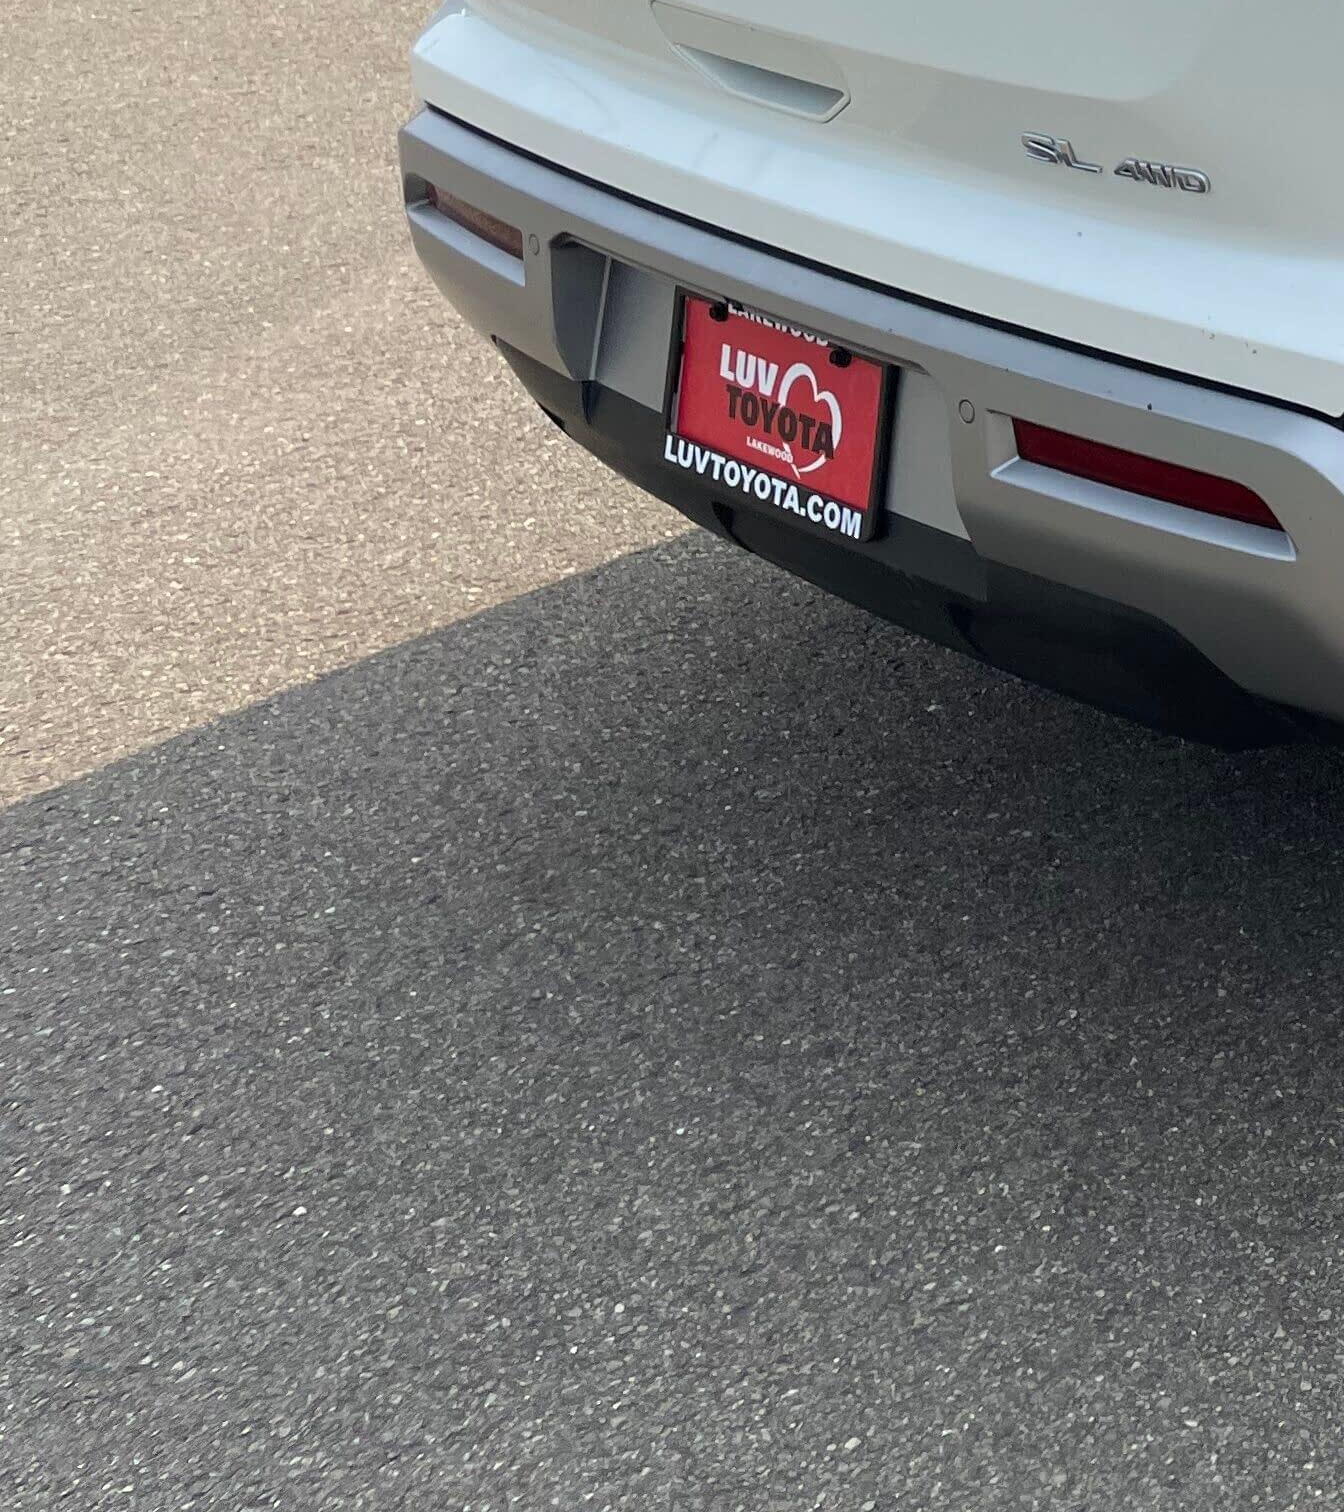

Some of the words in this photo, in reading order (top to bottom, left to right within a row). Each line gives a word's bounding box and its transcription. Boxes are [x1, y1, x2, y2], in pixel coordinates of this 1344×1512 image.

[1021, 130, 1103, 174] SL
[1113, 156, 1211, 194] 4WD
[719, 343, 779, 397] LUV
[726, 384, 834, 460] TOYOTA
[746, 436, 794, 465] LAKEWOOD
[664, 435, 863, 540] LUVTOYOTA.COM
